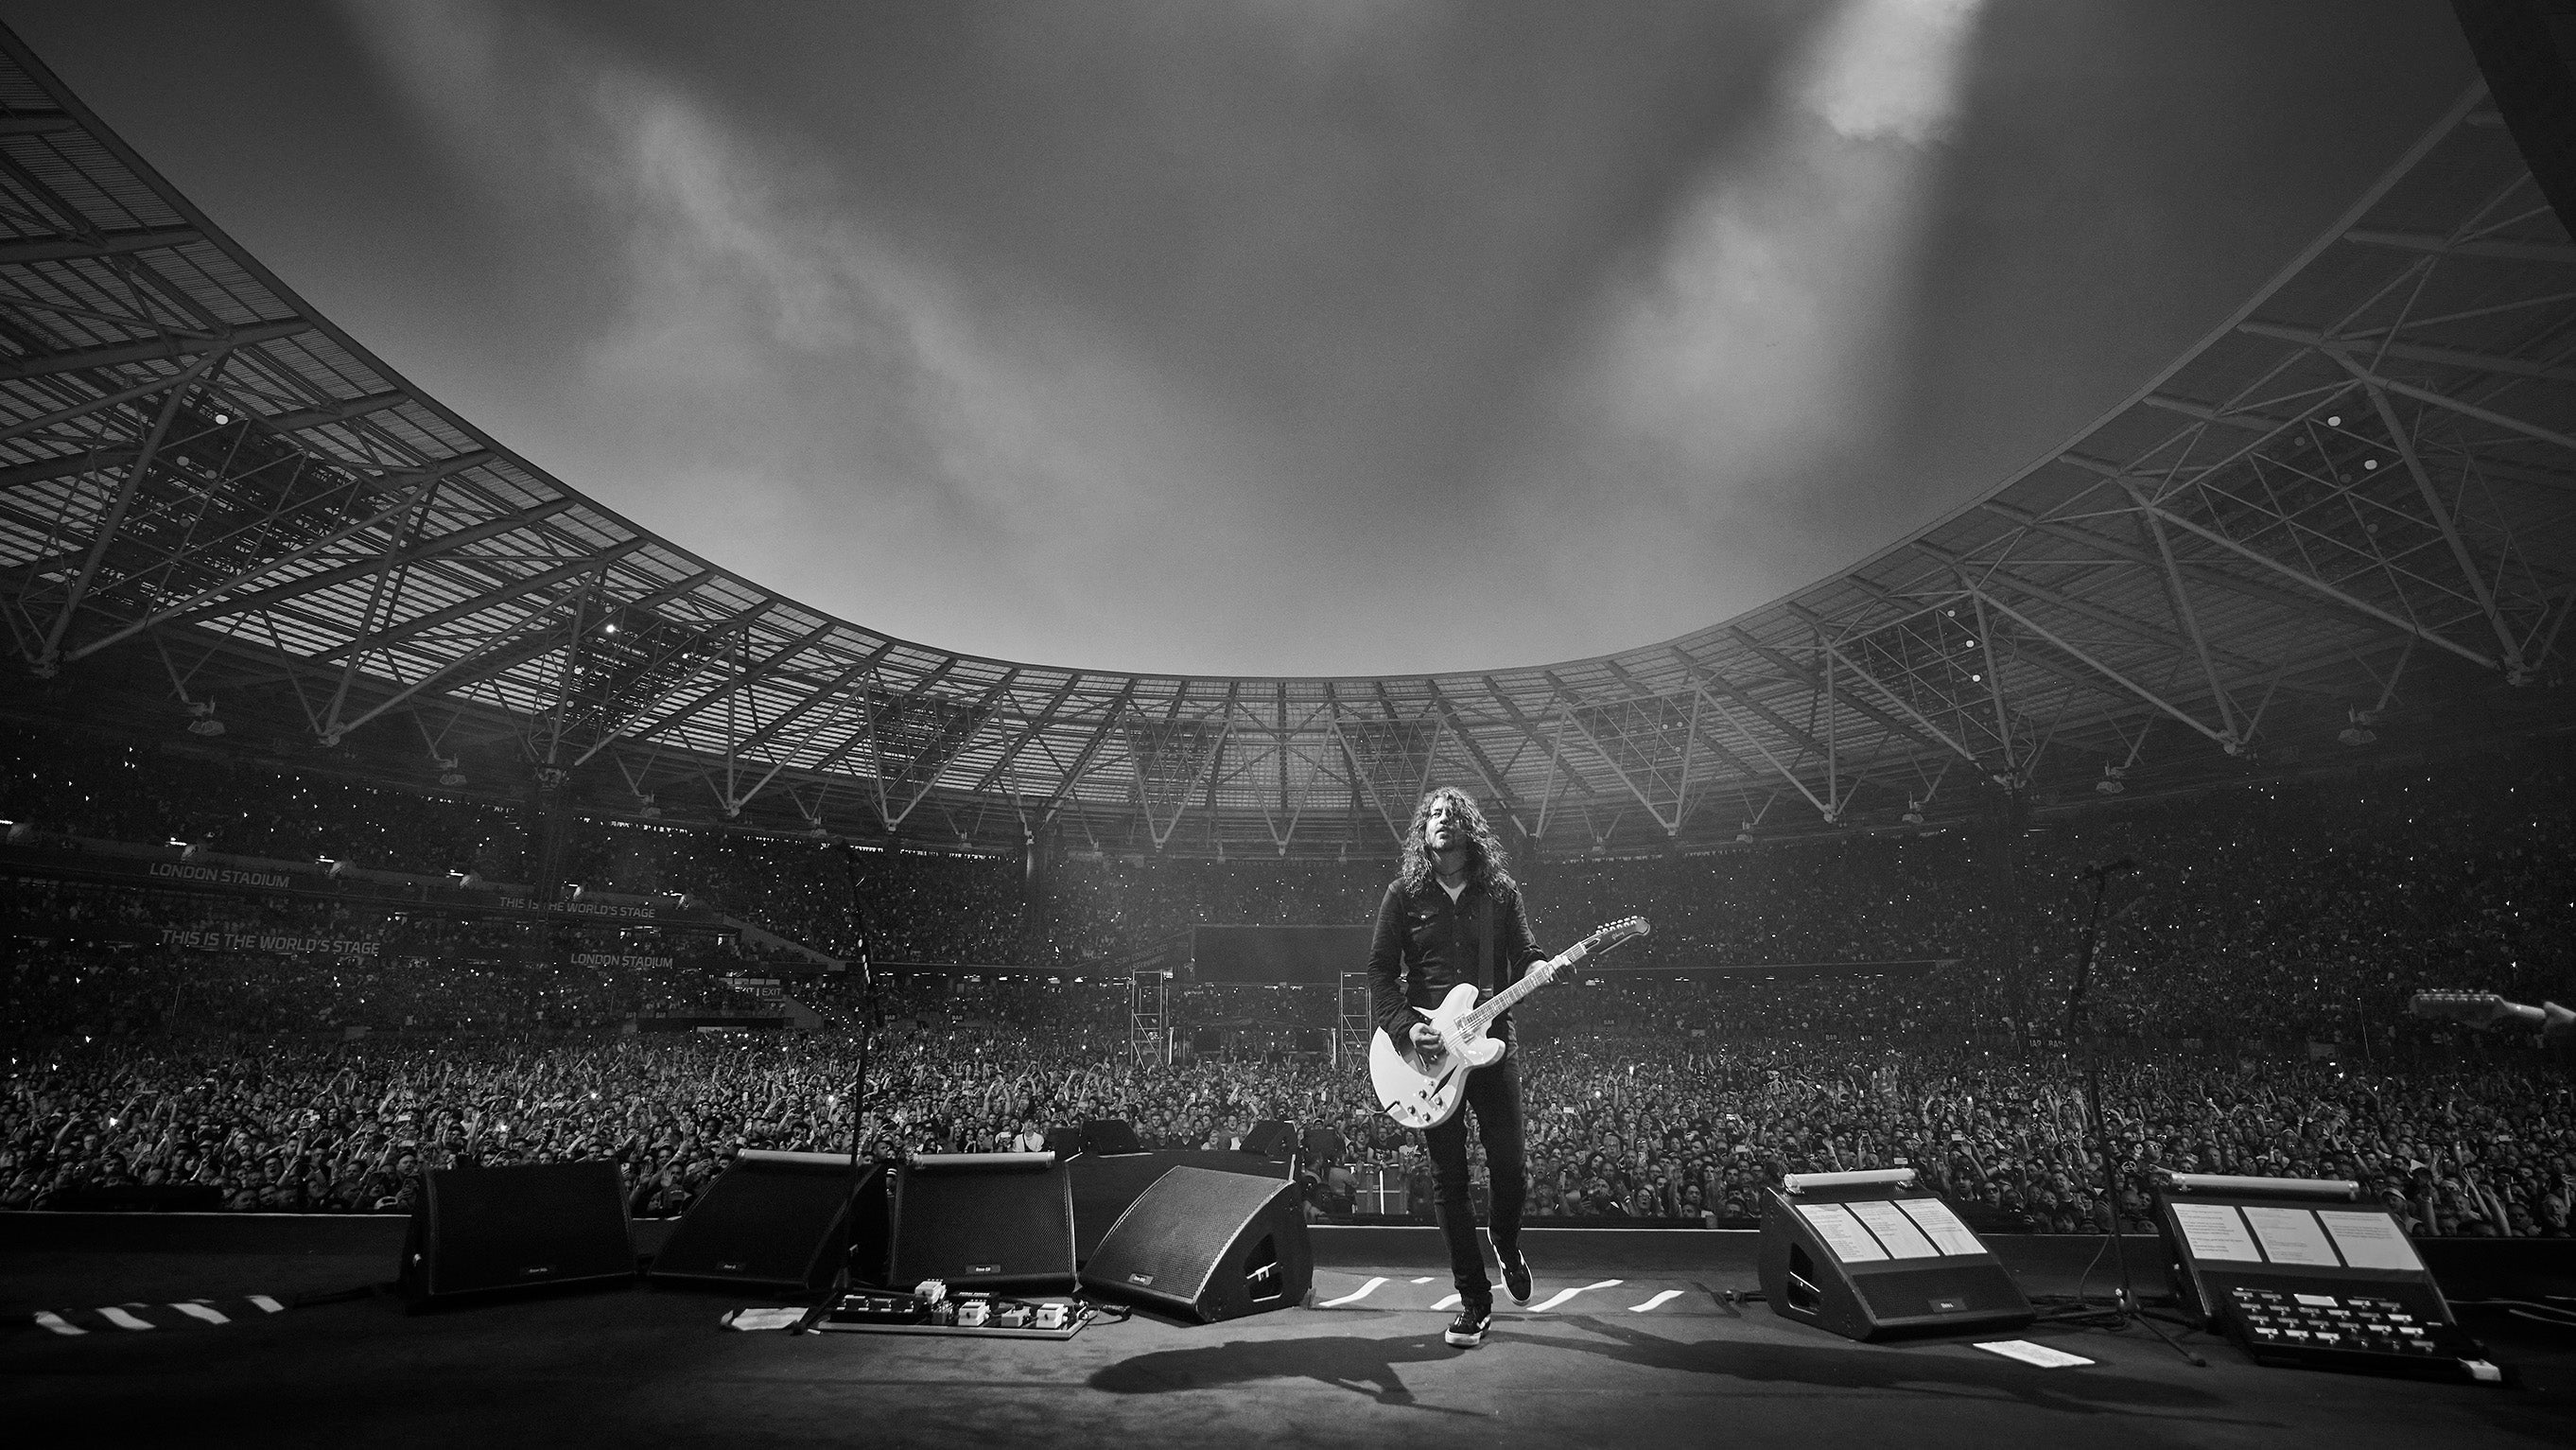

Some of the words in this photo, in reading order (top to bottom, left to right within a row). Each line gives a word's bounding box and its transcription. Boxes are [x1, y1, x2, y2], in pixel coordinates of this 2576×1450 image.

[149, 863, 218, 881] LONDON
[219, 870, 290, 887] STADIUM
[499, 897, 525, 908] THIS
[543, 901, 565, 912] HE
[567, 902, 618, 916] WORLD'S
[619, 907, 655, 917] STAGE
[161, 929, 201, 946] THIS
[203, 933, 219, 946] IS
[224, 934, 257, 949] THE
[259, 935, 330, 952] WORLD'S
[332, 941, 380, 955] STAGE
[570, 953, 619, 966] LONDON
[621, 956, 673, 968] STADIUM
[762, 987, 781, 996] EXIT
